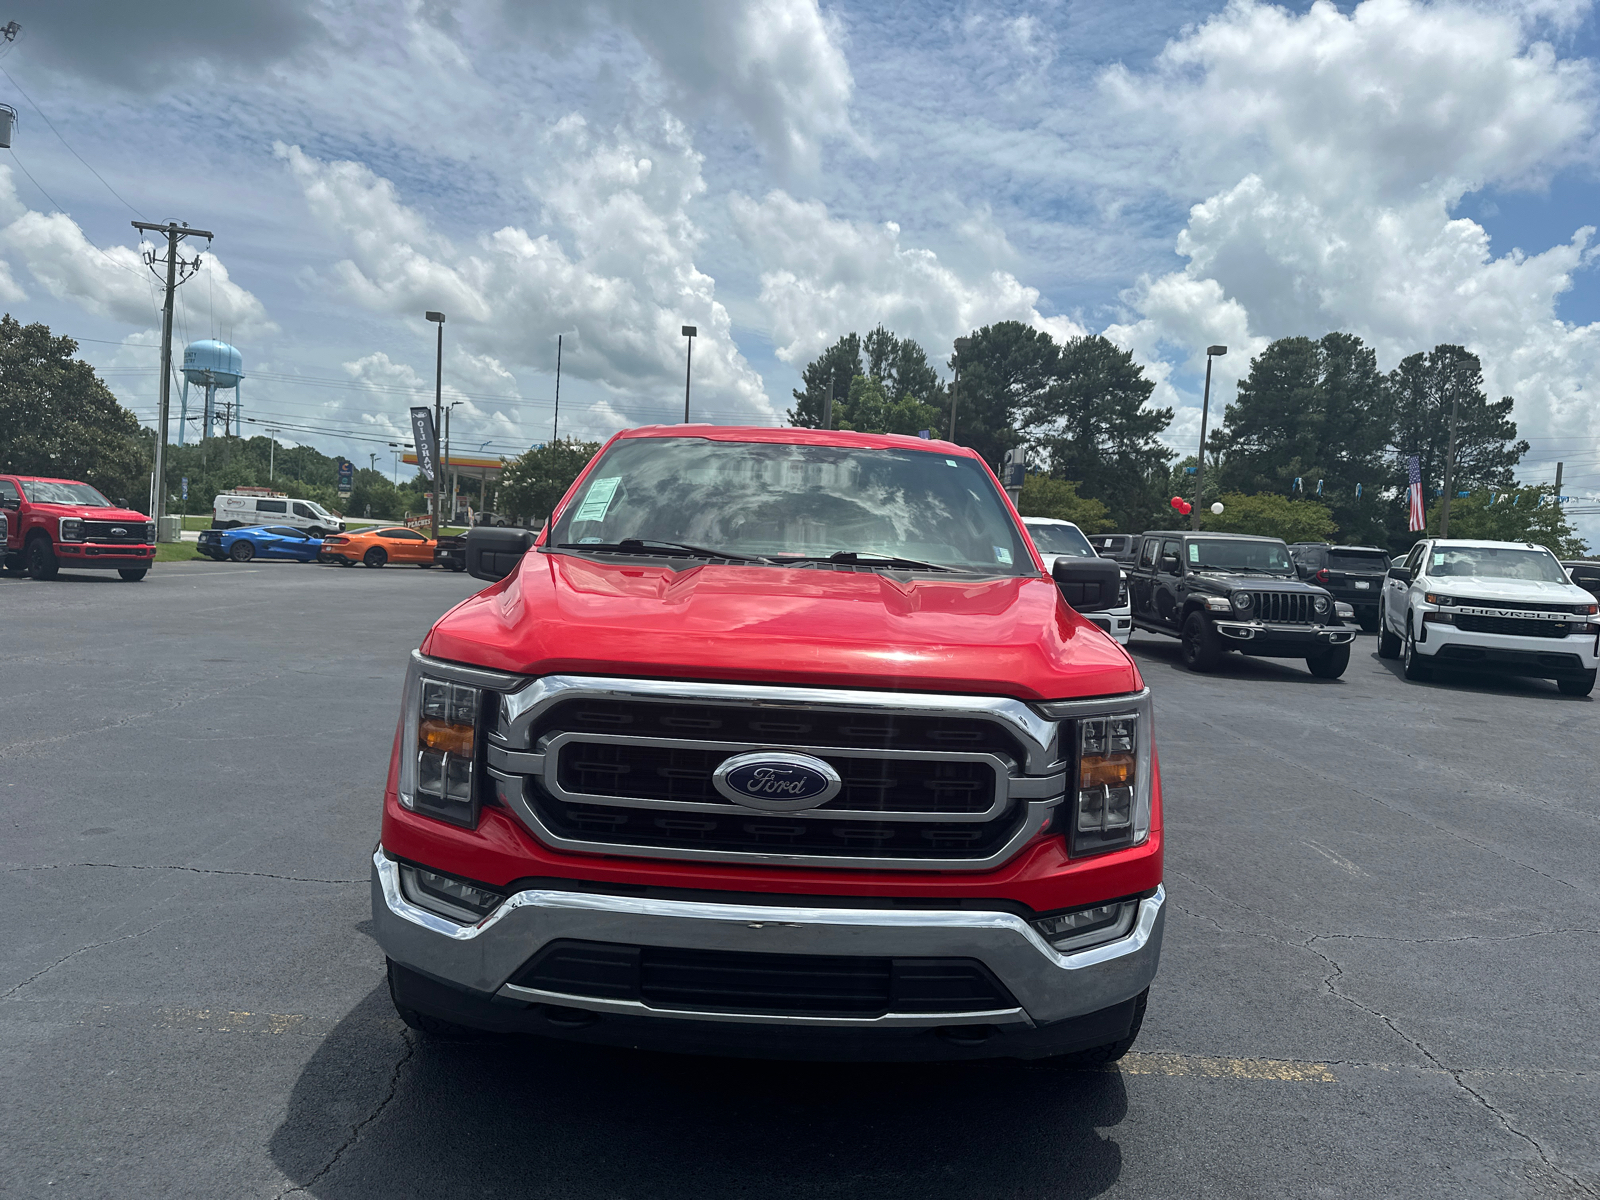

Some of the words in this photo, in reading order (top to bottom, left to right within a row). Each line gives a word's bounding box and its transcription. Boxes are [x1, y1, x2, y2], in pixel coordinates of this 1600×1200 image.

[407, 518, 431, 528] PEACHES
[1460, 607, 1571, 620] CHEVROLET
[747, 767, 806, 794] Ford
